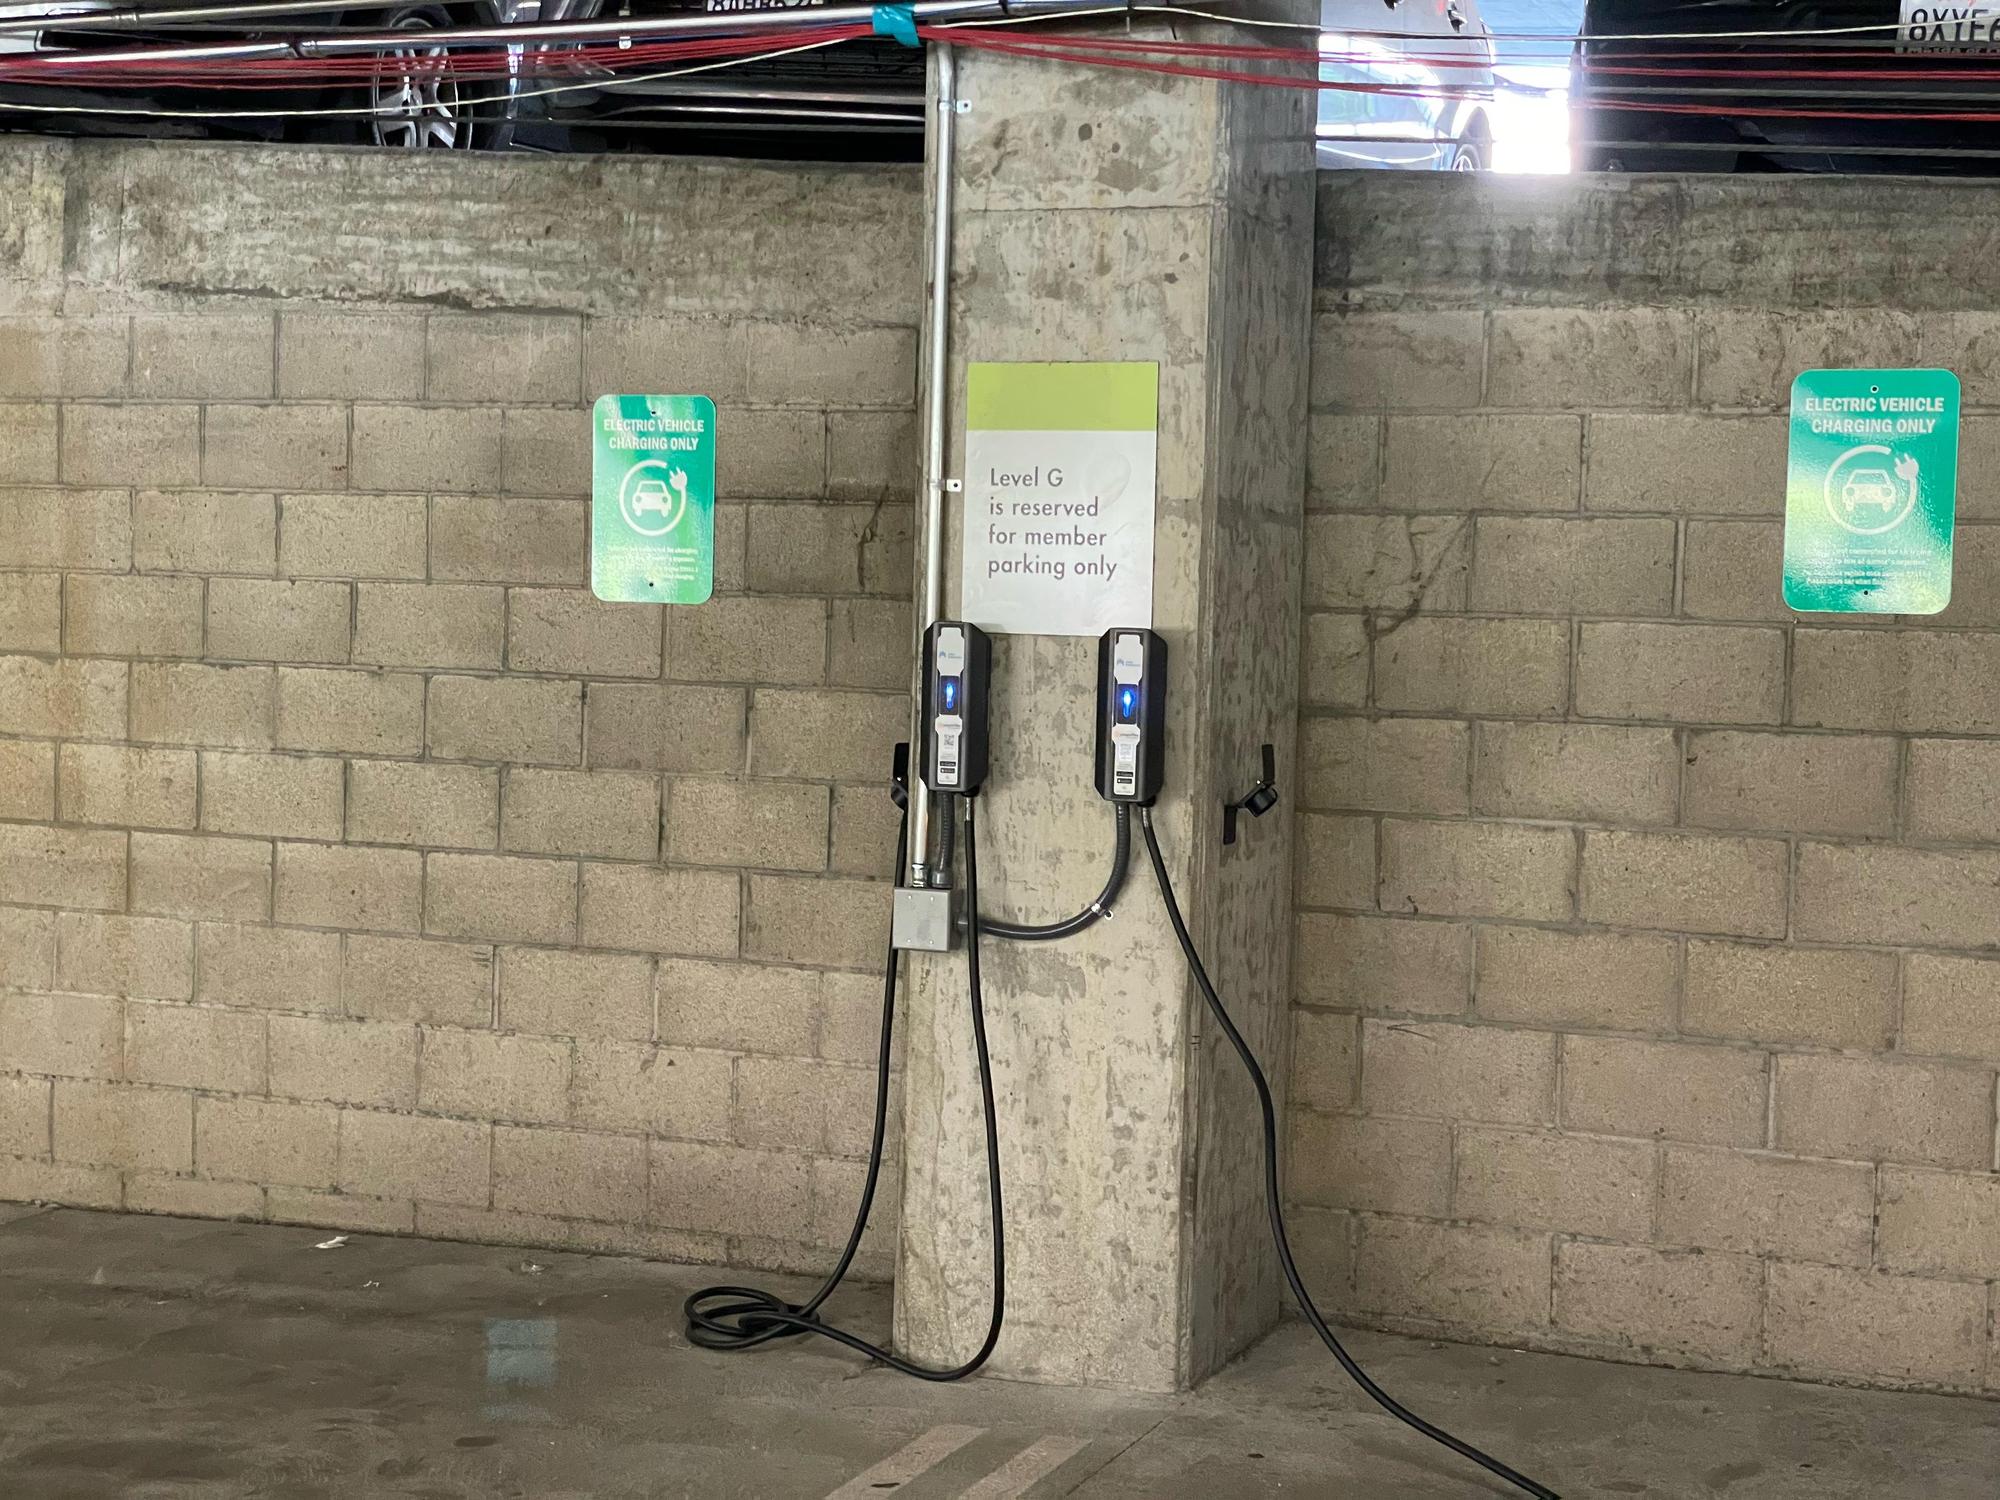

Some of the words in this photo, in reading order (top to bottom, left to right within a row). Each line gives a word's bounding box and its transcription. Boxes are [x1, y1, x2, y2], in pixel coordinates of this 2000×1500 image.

[1805, 397, 1877, 412] ELECTRIC
[1879, 397, 1945, 412] VEHICLE
[603, 418, 656, 432] ELECTRIC
[657, 419, 705, 433] VEHICLE
[1811, 418, 1893, 433] CHARGING
[1896, 419, 1936, 434] ONLY
[608, 436, 668, 450] CHARGING
[670, 437, 699, 451] ONLY
[990, 466, 1039, 487] Level
[1047, 468, 1064, 487] G
[989, 496, 1004, 516] is
[1012, 496, 1099, 517] reserved
[988, 523, 1017, 545] for
[1024, 524, 1107, 546] member
[988, 553, 1065, 580] parking
[1074, 554, 1118, 582] only
